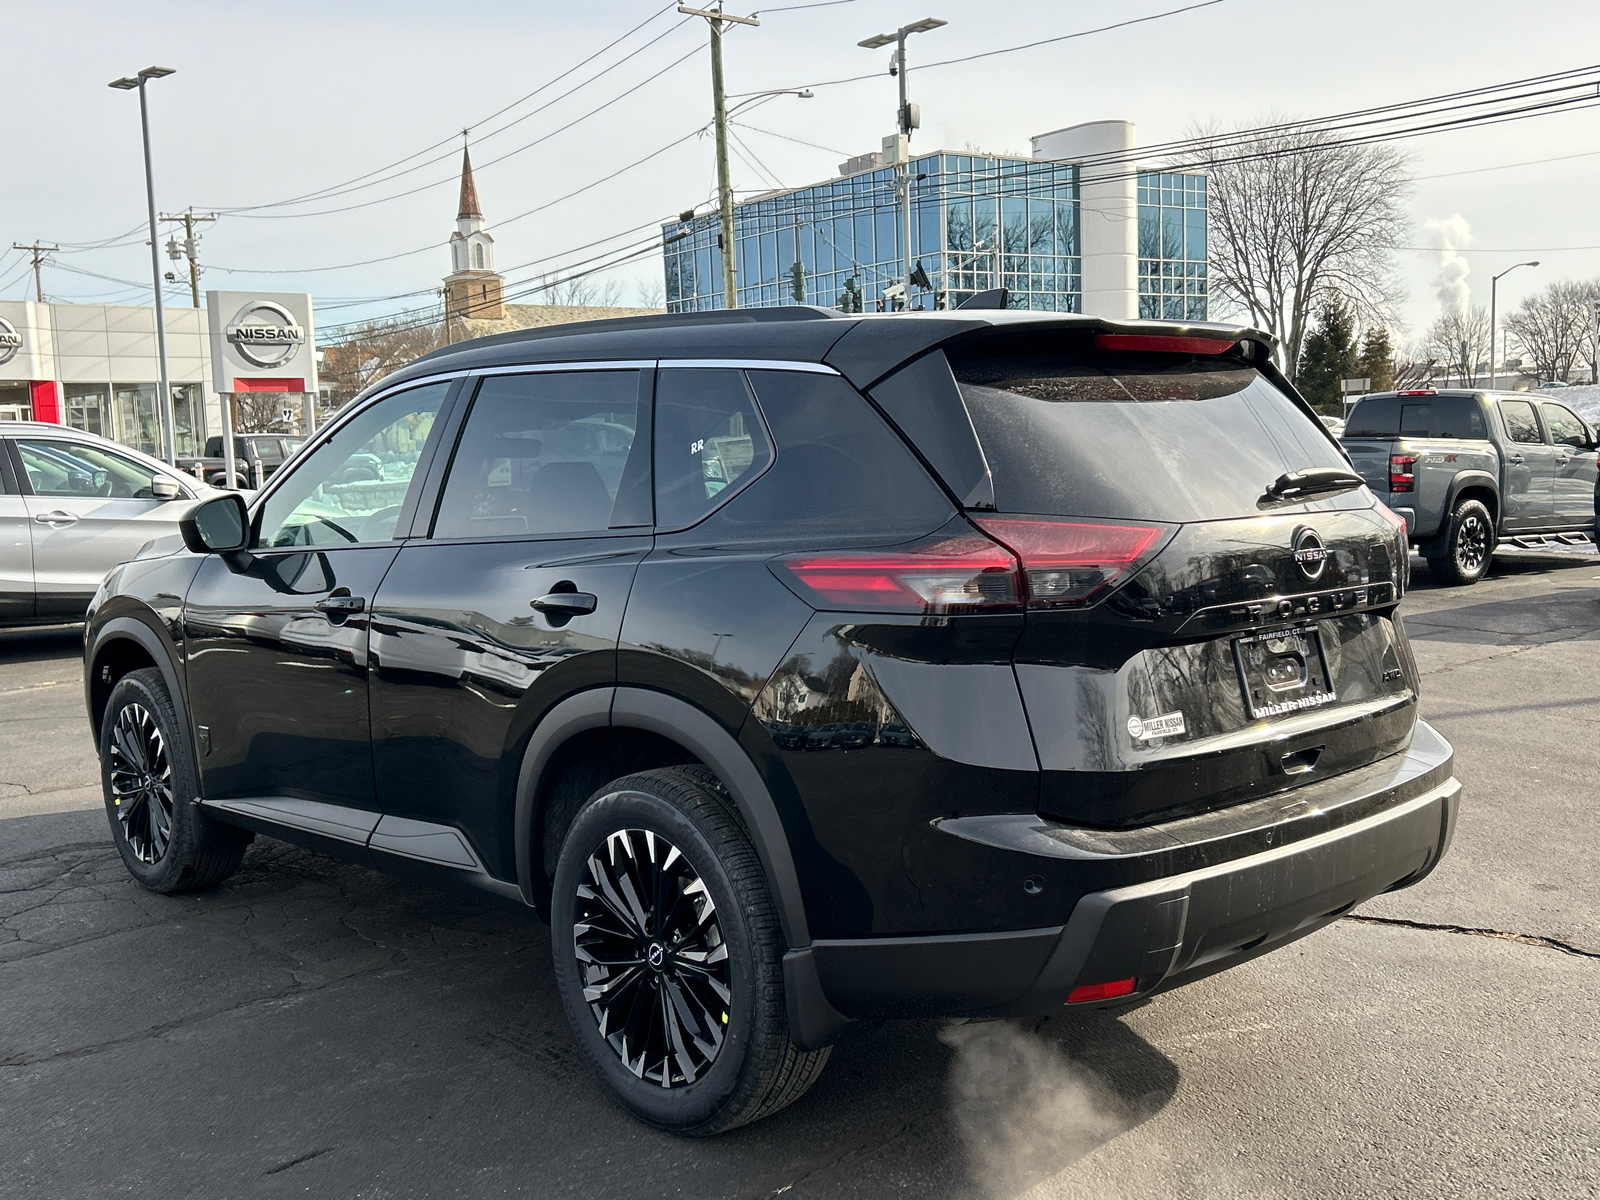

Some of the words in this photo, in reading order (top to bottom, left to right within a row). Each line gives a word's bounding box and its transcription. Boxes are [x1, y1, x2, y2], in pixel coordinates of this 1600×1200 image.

[236, 328, 298, 340] NISSAN
[691, 439, 704, 454] RR
[1295, 549, 1328, 562] NISSAN
[1248, 590, 1368, 625] ROGUE
[1254, 701, 1298, 718] MILLER
[1297, 692, 1337, 708] NISSAN
[1143, 720, 1164, 732] MILLER
[1164, 717, 1183, 728] NISSAN
